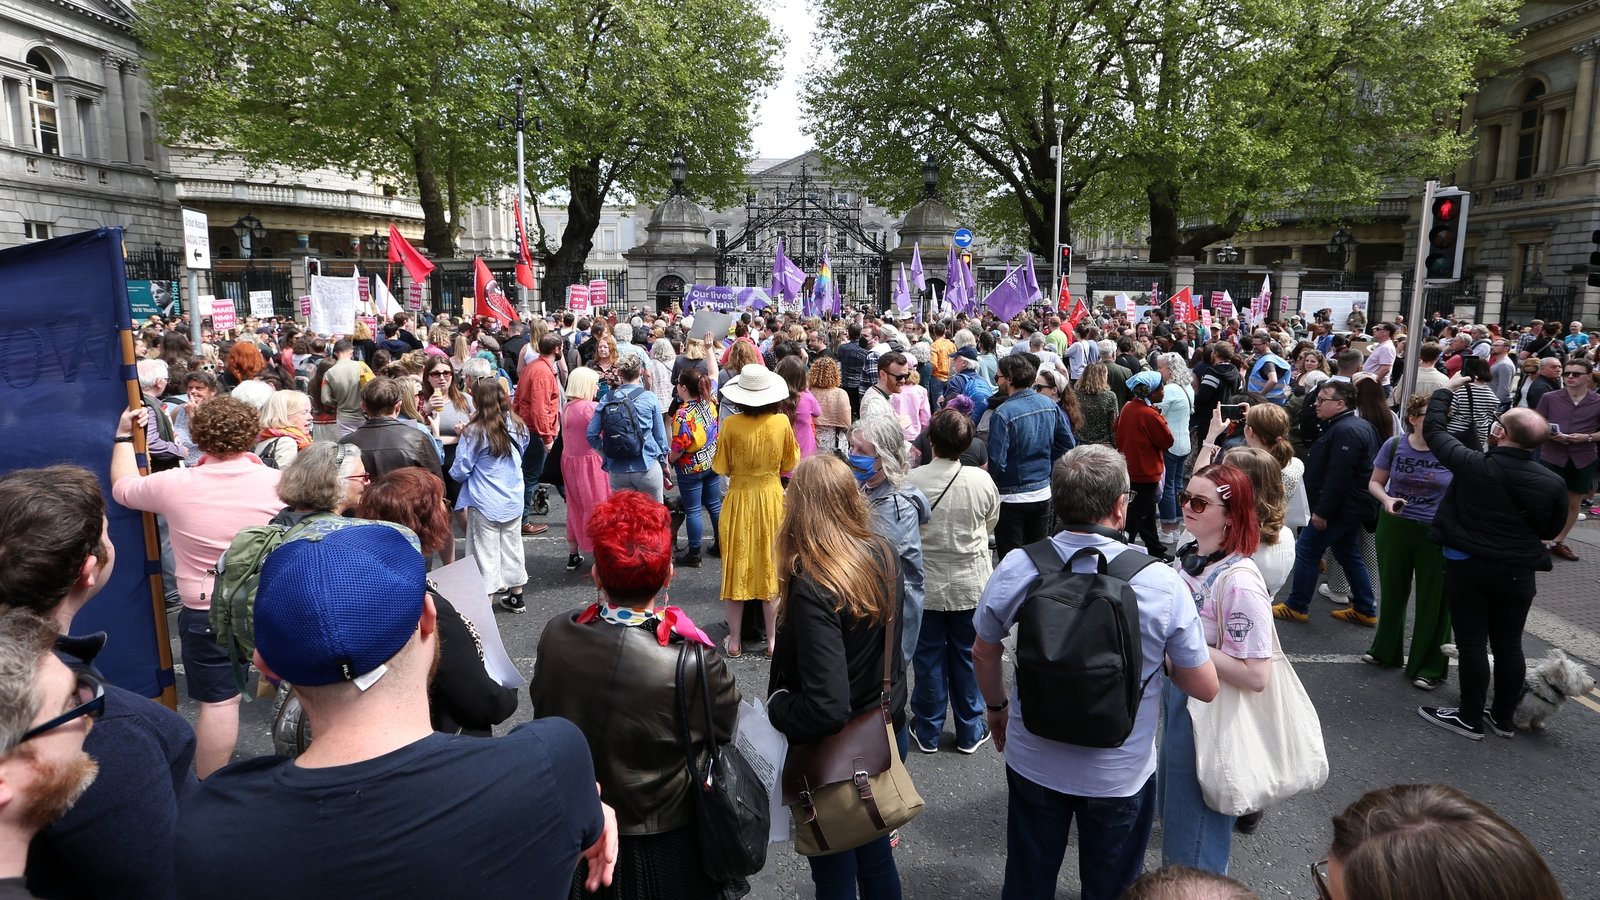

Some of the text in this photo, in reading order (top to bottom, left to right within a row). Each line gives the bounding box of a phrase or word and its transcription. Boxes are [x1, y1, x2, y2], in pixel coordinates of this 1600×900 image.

[172, 281, 181, 316] HIBITION
[693, 290, 710, 298] Our
[213, 306, 235, 314] MAKE
[215, 321, 235, 330] OURS
[1396, 464, 1415, 474] NO
